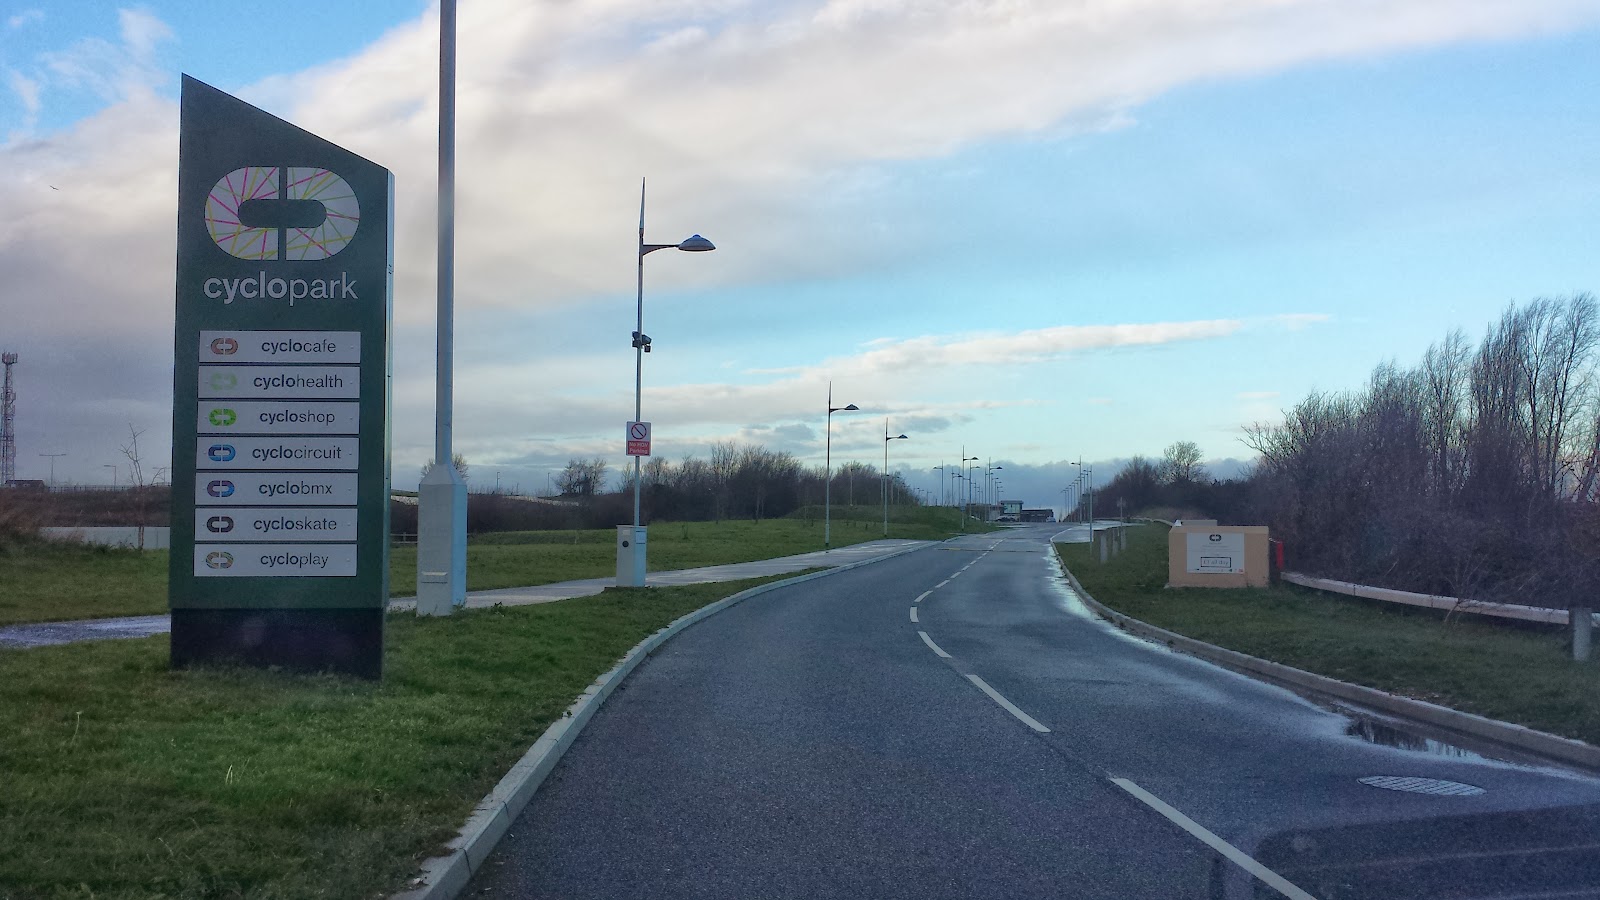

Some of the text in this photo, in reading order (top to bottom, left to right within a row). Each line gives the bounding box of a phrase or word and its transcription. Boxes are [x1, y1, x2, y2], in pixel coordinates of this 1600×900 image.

[203, 270, 358, 307] cyclopark
[261, 338, 337, 355] cyclocafe
[253, 373, 344, 390] cyclohealth
[259, 409, 336, 426] cycloshop
[252, 445, 342, 462] cyclocircuit
[258, 481, 333, 497] cyclobmx
[253, 516, 338, 533] cycloskate
[260, 552, 329, 569] cycloplay
